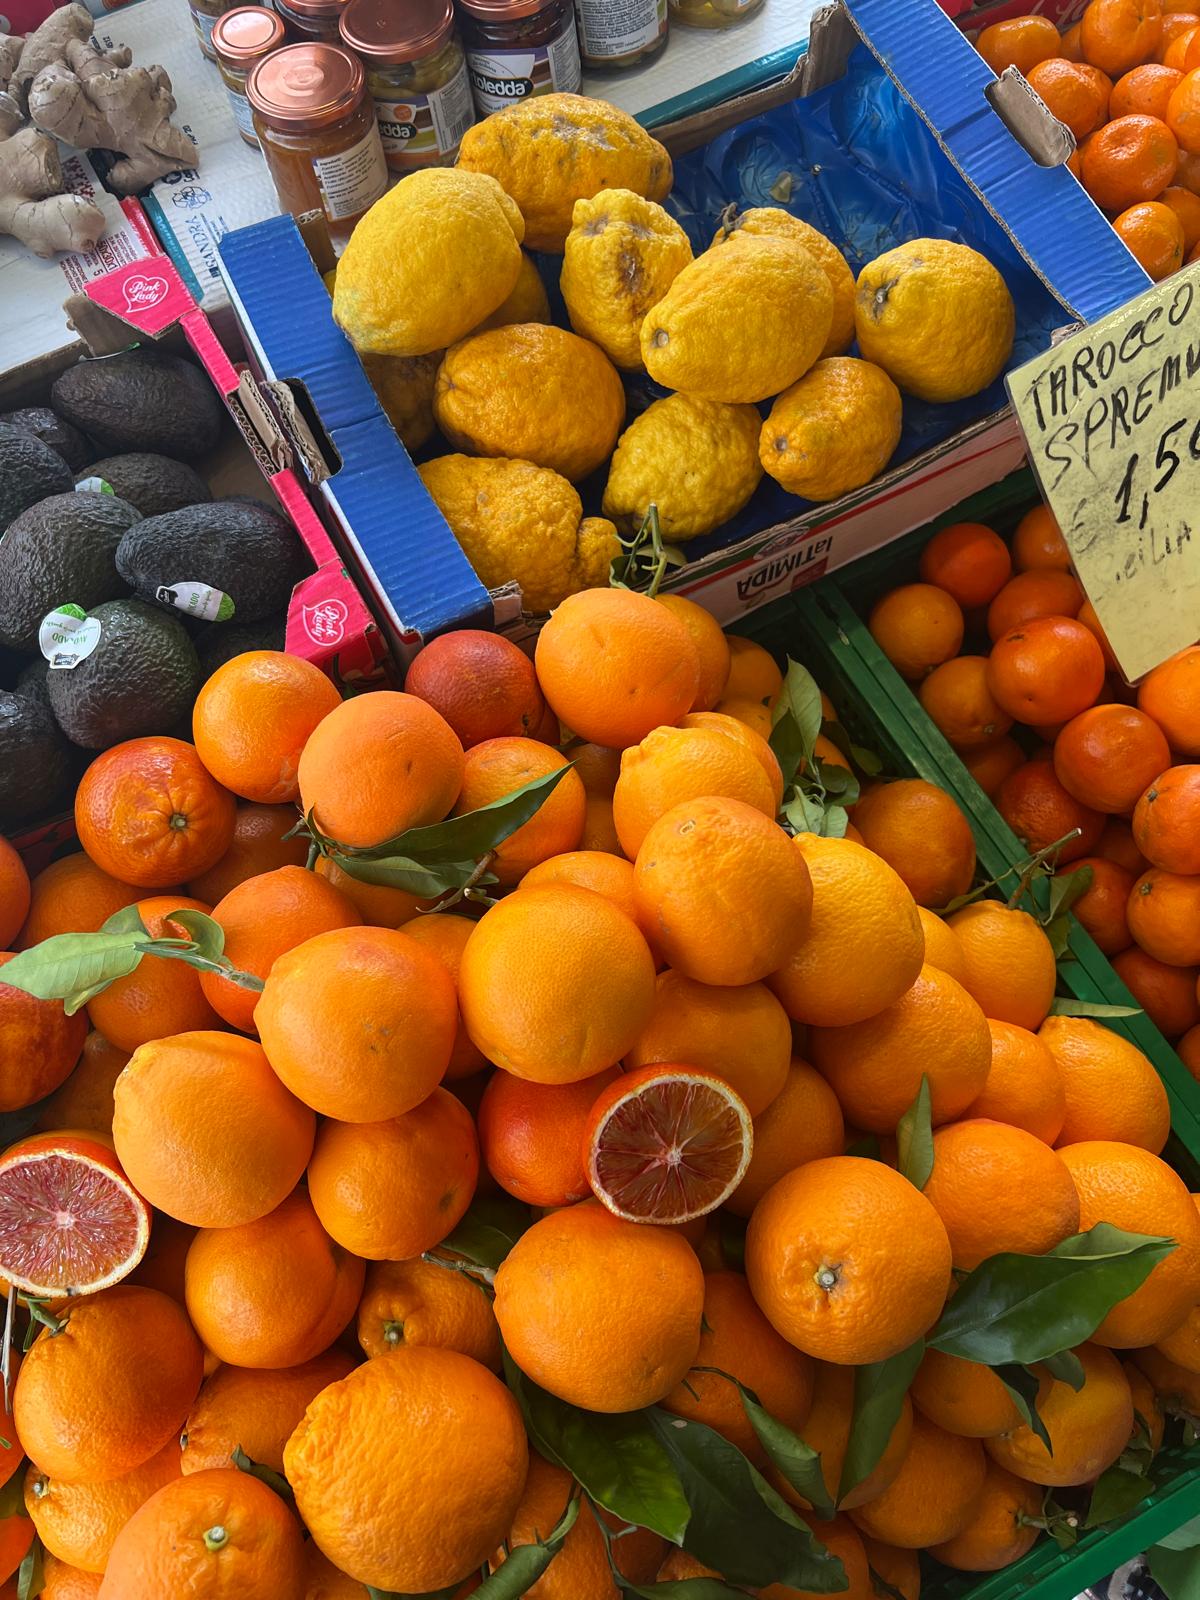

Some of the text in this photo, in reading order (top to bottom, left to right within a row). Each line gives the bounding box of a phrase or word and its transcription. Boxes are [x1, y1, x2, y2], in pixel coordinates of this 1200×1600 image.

[92, 268, 103, 276] 5
[129, 281, 160, 293] Pink
[130, 291, 159, 303] Lady
[1023, 282, 1194, 431] TAROCCO
[736, 535, 833, 600] laTIMIDA
[311, 607, 326, 638] Lady
[324, 606, 340, 636] Pink
